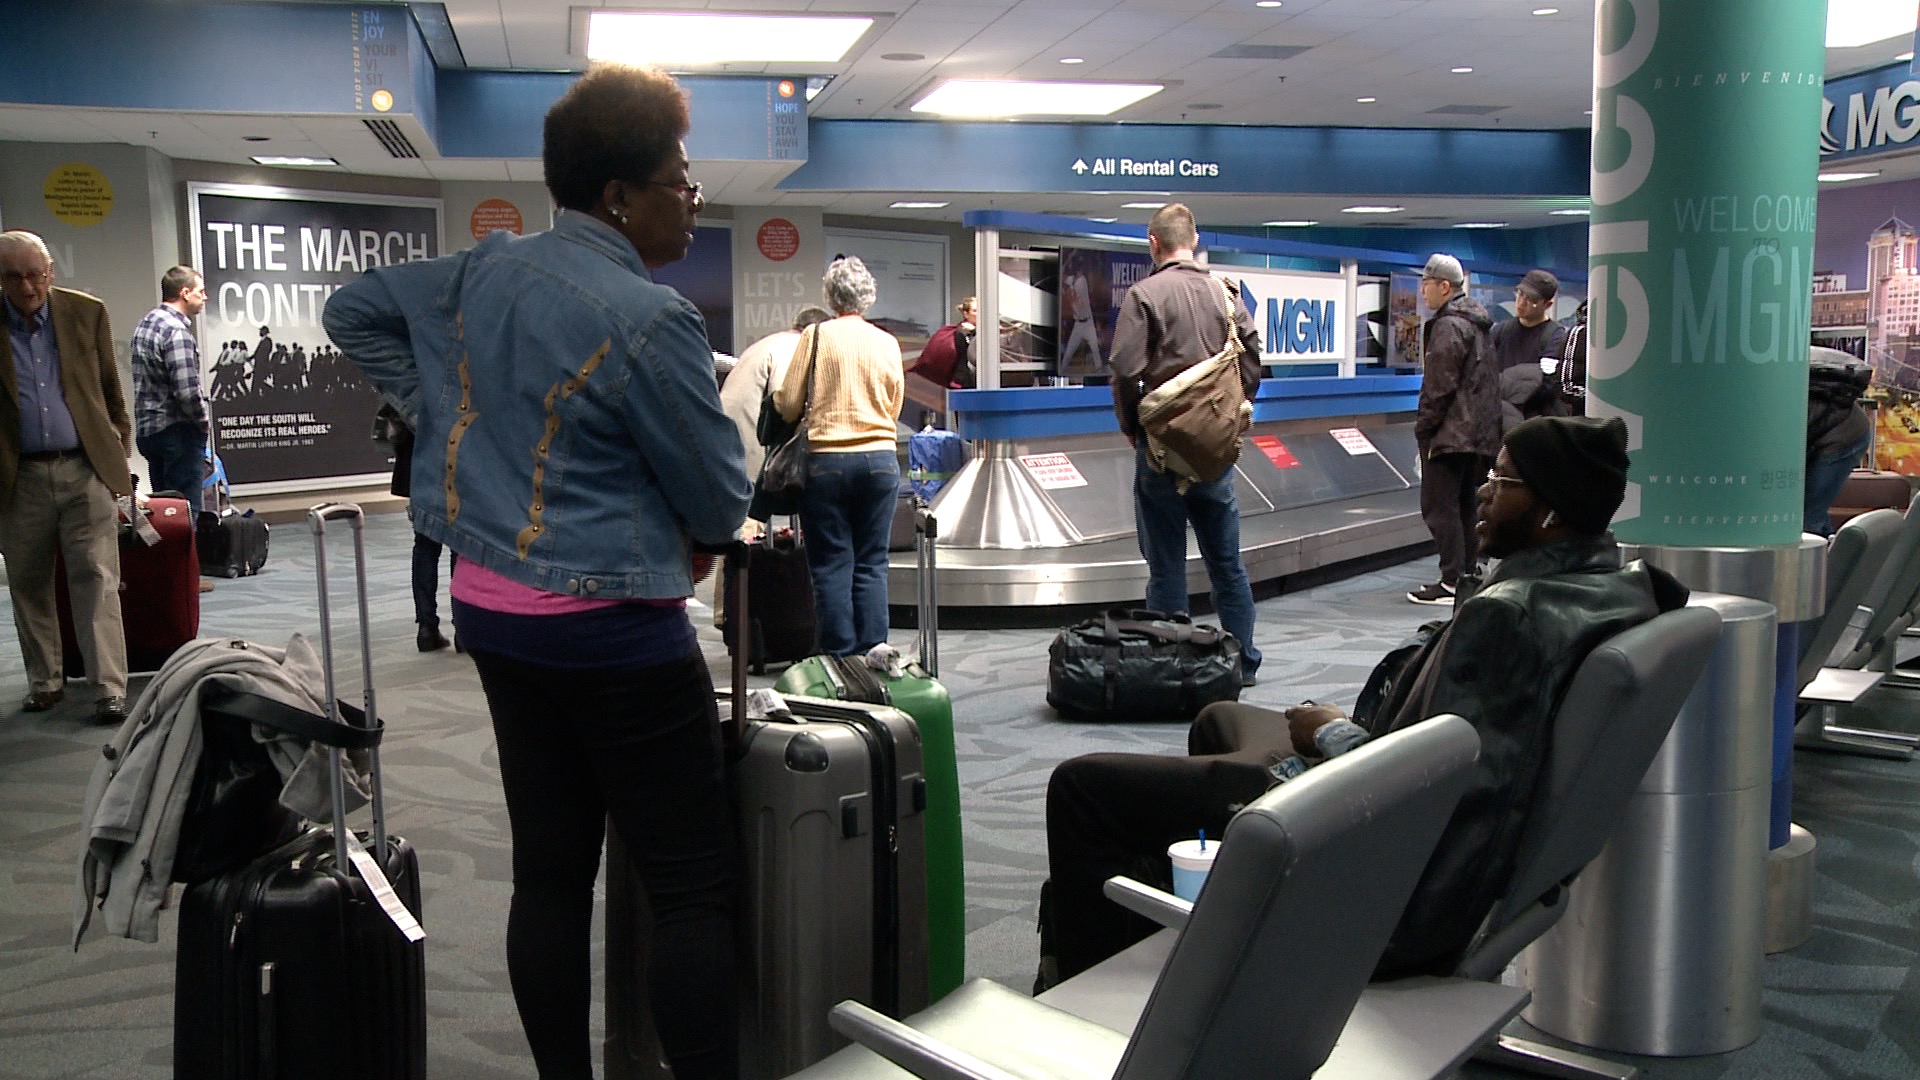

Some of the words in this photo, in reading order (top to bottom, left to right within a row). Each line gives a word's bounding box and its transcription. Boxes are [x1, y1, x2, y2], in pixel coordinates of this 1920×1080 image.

[363, 25, 385, 41] JOY
[774, 102, 800, 114] HOPE
[1092, 158, 1115, 175] All
[1120, 158, 1174, 176] Rental
[1179, 159, 1219, 177] Cars
[1673, 194, 1817, 233] WELCOME
[207, 222, 287, 271] THE
[300, 227, 428, 272] MARCH
[744, 272, 805, 297] LET'S
[1671, 245, 1815, 364] MGM
[1266, 297, 1336, 354] MGM
[239, 415, 255, 426] DAY
[256, 415, 270, 425] THE
[272, 413, 296, 424] SOUTH
[298, 412, 316, 423] WILL
[221, 428, 263, 440] RECOGNIZE
[264, 427, 277, 438] ITS
[278, 425, 297, 436] REAL
[1649, 475, 1748, 485] WELCOME
